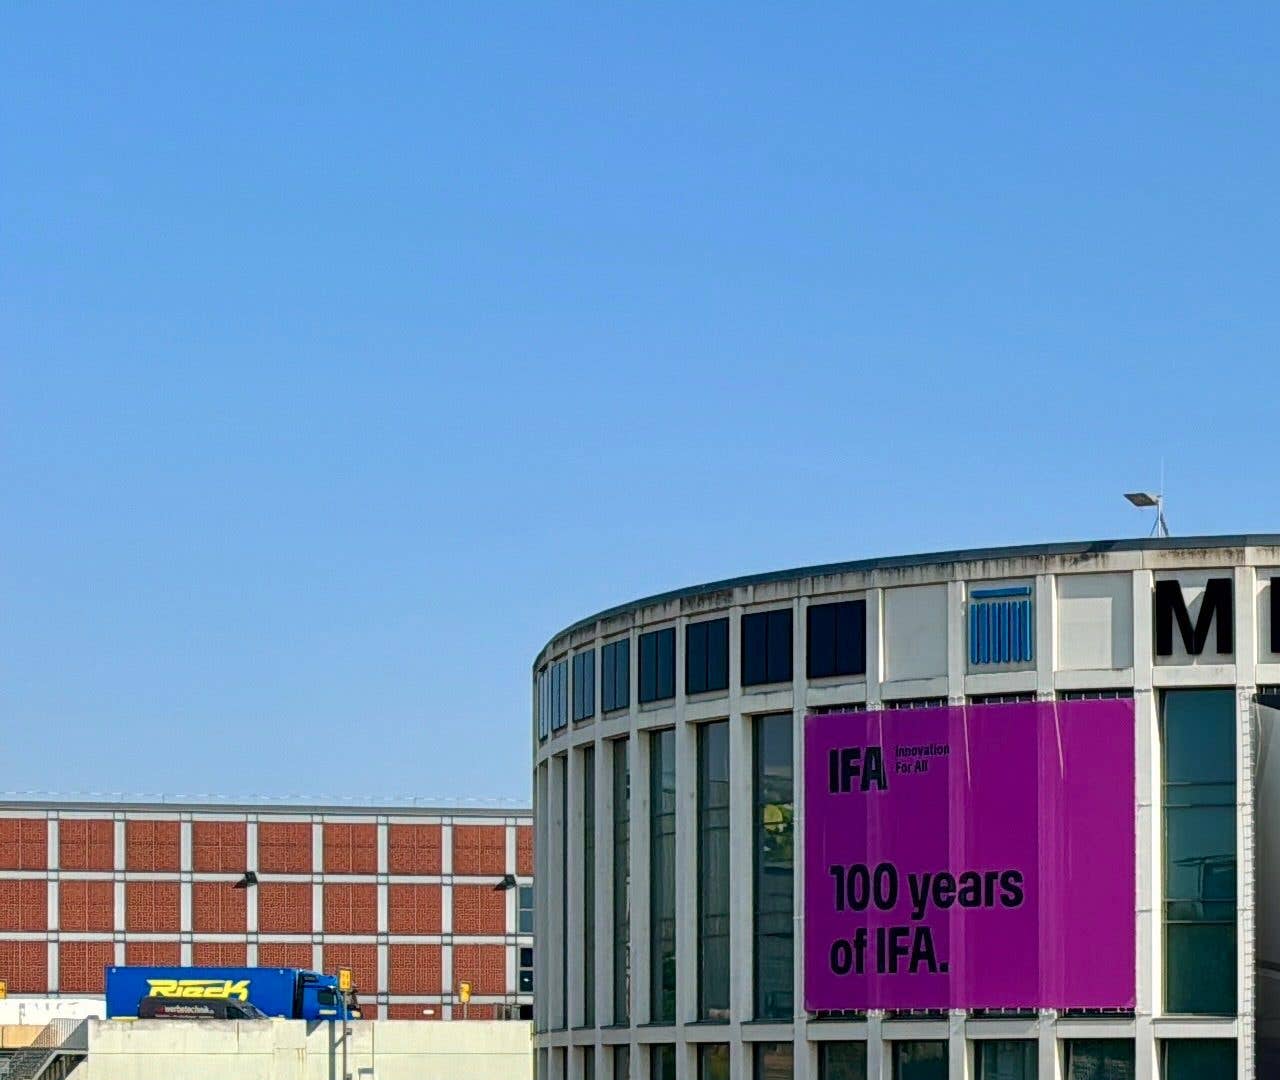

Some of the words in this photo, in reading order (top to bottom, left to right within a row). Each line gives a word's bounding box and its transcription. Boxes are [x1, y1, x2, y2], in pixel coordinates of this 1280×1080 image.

[829, 746, 888, 793] IFA
[895, 744, 950, 757] Innovation
[896, 761, 911, 773] For
[914, 760, 928, 772] All
[829, 862, 899, 912] 100
[907, 869, 1025, 921] years
[830, 927, 868, 976] of
[876, 925, 950, 974] IFA.
